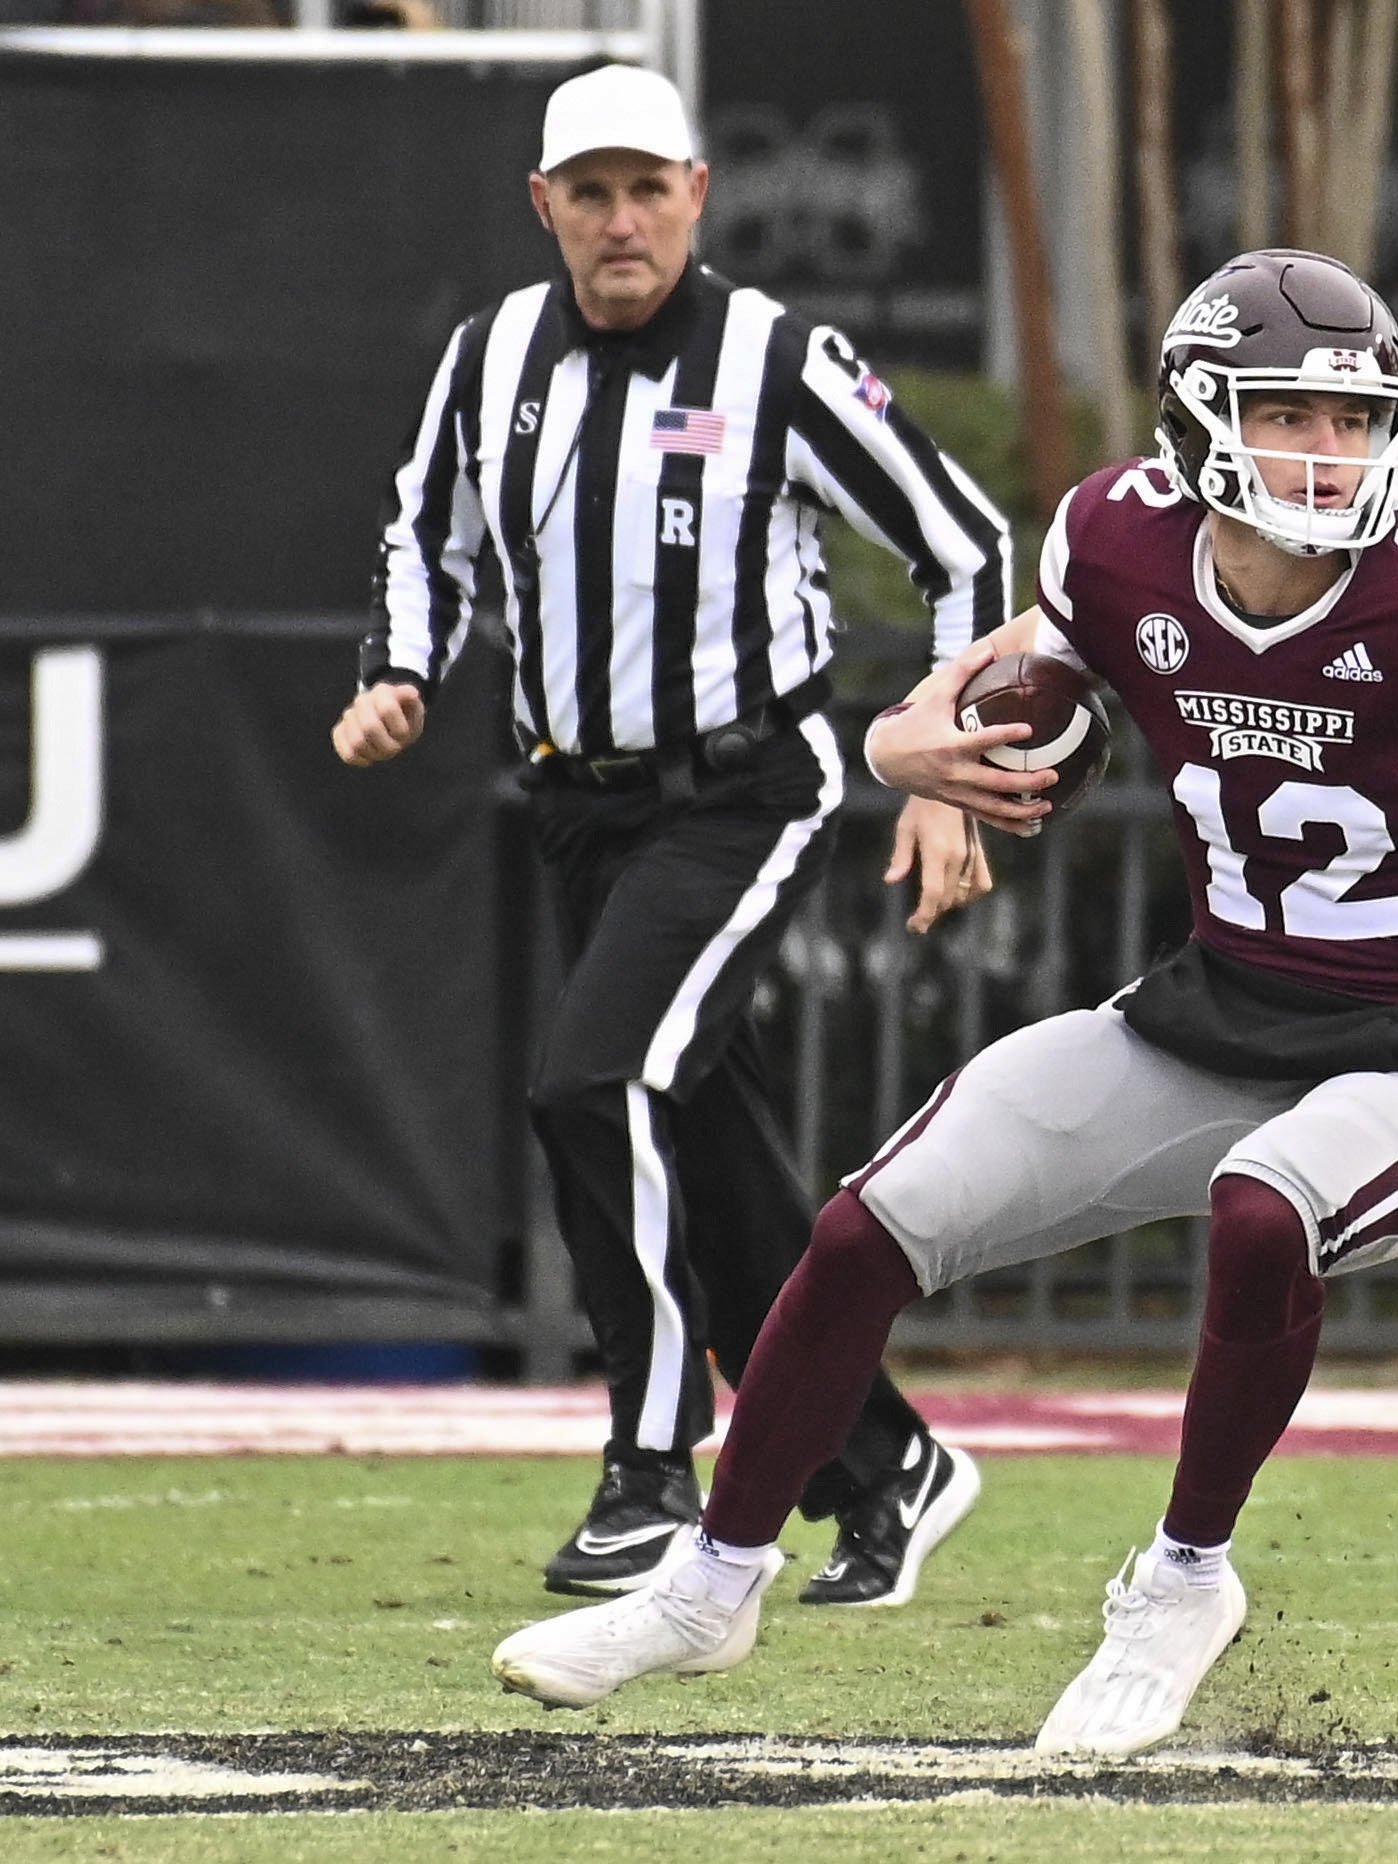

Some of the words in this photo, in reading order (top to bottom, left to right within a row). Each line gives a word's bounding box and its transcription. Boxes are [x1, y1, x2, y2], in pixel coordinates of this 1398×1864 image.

[661, 498, 695, 547] R
[1140, 618, 1184, 670] SEC
[1322, 665, 1384, 683] adidas
[1175, 697, 1354, 739] MISSISSIPPI
[1229, 734, 1304, 763] STATE
